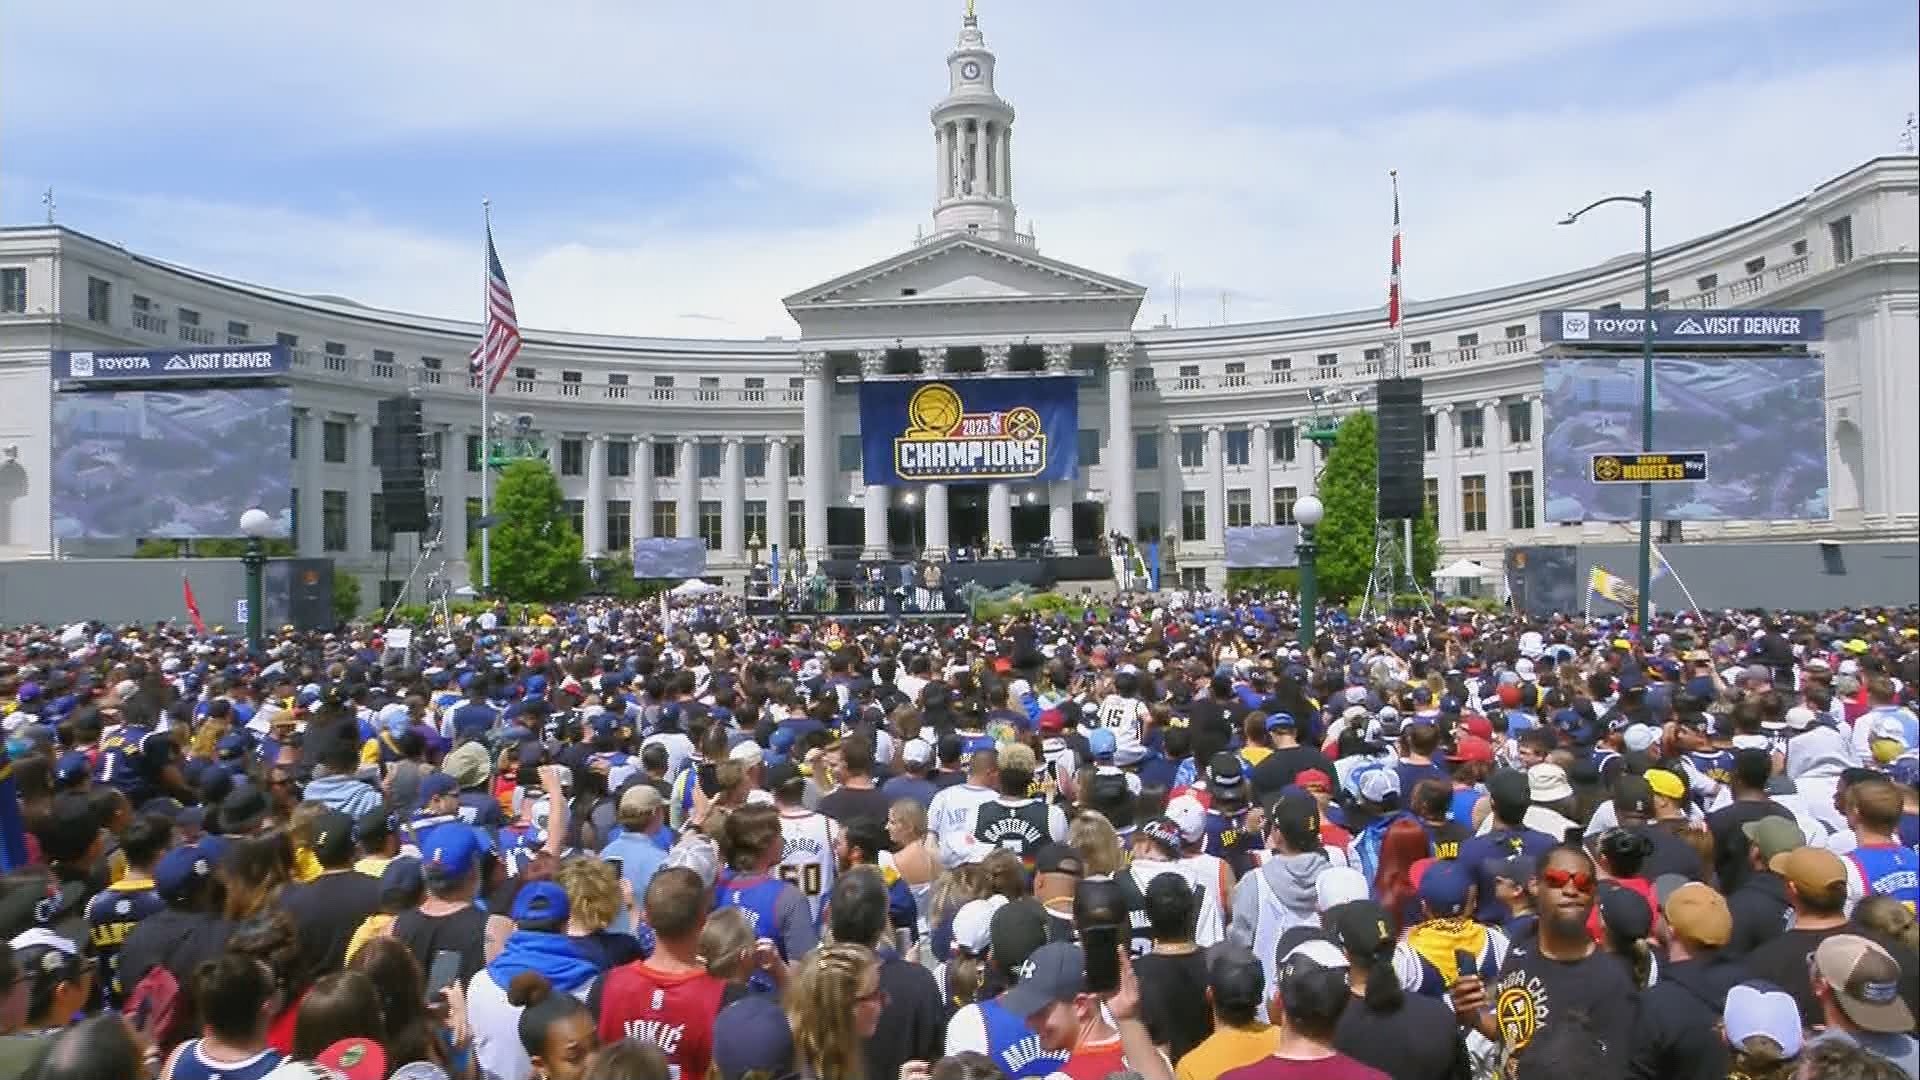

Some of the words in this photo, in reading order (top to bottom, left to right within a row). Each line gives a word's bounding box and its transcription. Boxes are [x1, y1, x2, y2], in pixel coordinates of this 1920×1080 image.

[1594, 319, 1658, 332] TOYOT
[1704, 318, 1741, 334] VISIT
[1744, 317, 1801, 334] DENVER
[97, 356, 151, 370] TOYOTA
[189, 353, 222, 370] VISIT
[223, 352, 272, 369] DENVER
[963, 419, 988, 435] 2023
[901, 440, 1041, 467] CHAMPIONS
[1106, 709, 1124, 727] 15
[984, 818, 1030, 842] BARTON
